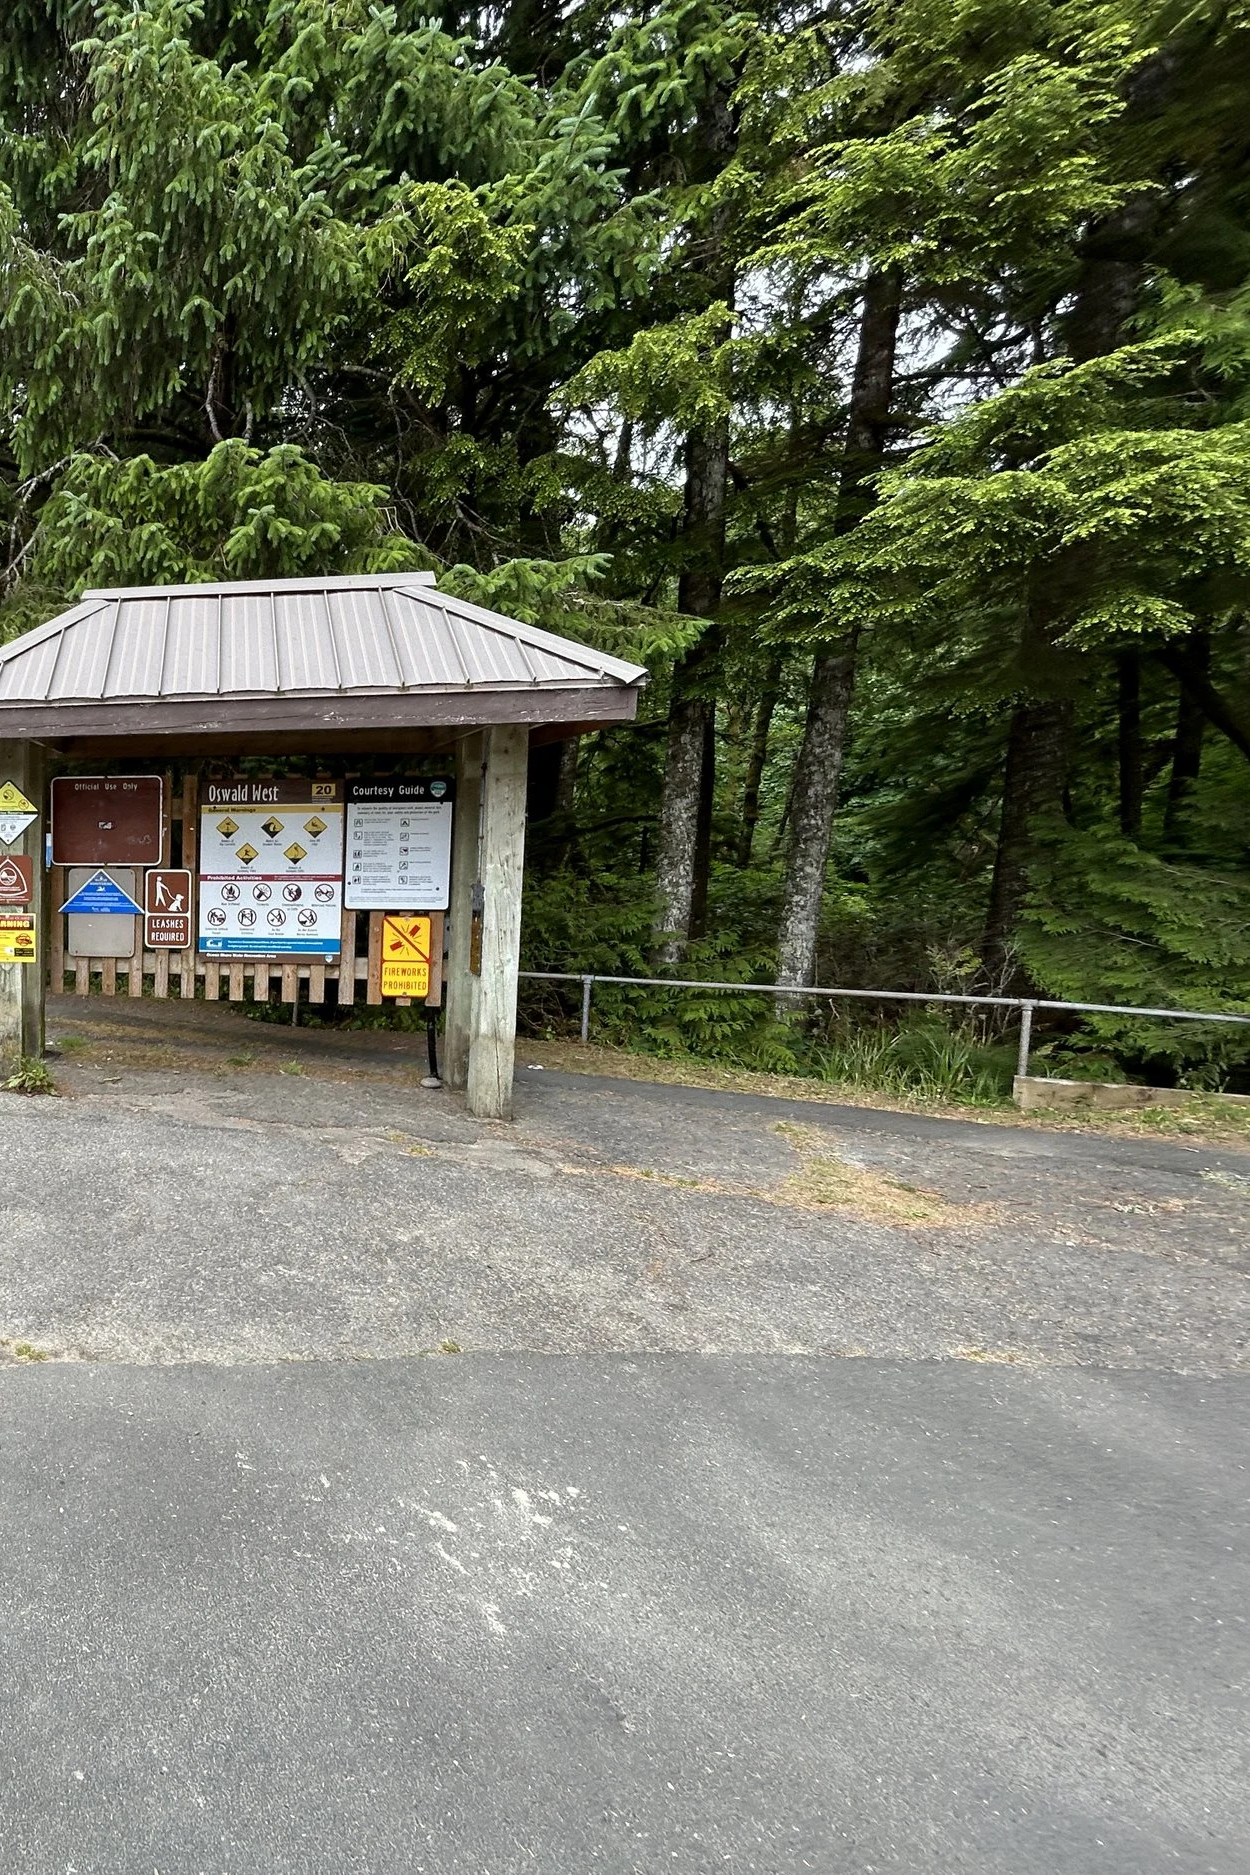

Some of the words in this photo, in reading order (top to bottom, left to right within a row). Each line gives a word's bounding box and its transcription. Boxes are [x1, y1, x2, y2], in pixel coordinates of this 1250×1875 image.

[74, 783, 100, 791] Official
[122, 782, 138, 791] Only
[315, 785, 332, 795] 20
[352, 785, 394, 797] Courtesy
[398, 785, 425, 795] Guide
[208, 784, 248, 802] Oswald
[252, 784, 279, 801] West
[152, 919, 184, 929] LEASHES
[151, 932, 185, 941] REQUIRED
[384, 967, 427, 977] FIREWORKS
[383, 981, 427, 990] PROHIBITED
